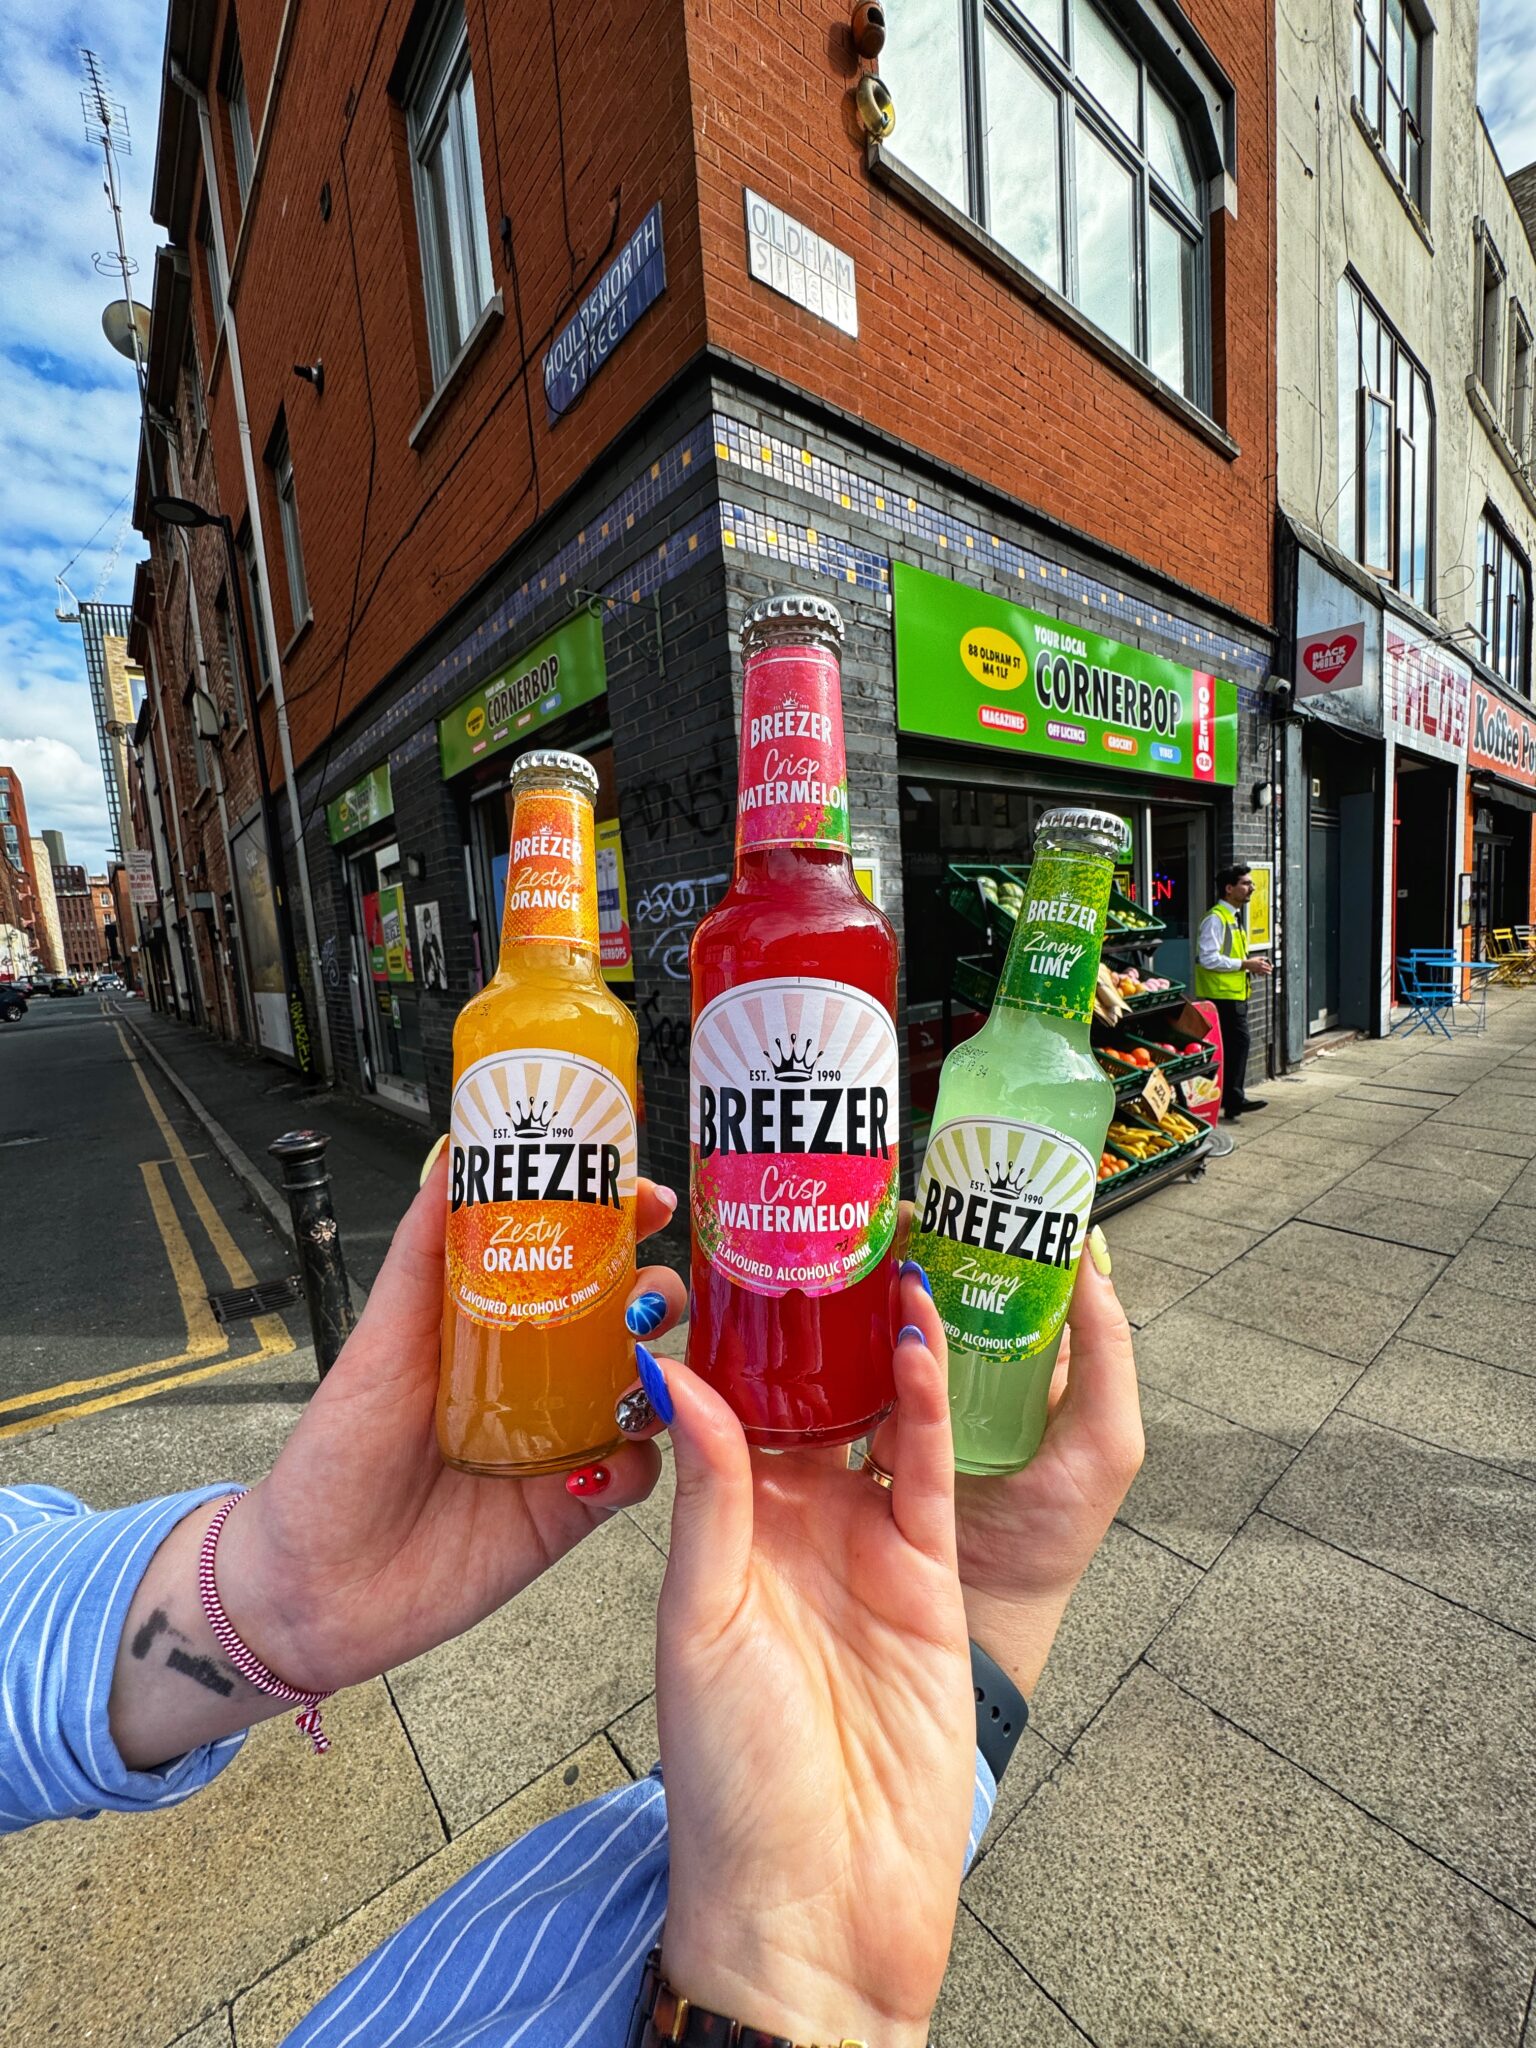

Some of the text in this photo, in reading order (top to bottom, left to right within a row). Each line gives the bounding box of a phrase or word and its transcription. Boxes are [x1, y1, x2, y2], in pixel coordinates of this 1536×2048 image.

[752, 204, 851, 292] OLDHAM
[546, 215, 656, 386] HOULDSWORTH
[569, 298, 629, 393] STREET
[967, 643, 1020, 670] 88 OLDHAM ST
[1034, 625, 1087, 658] YOUR LOCAL
[1312, 644, 1347, 660] BLACK
[982, 662, 994, 675] M4
[1312, 655, 1346, 671] MILK
[487, 654, 559, 729] CORNERBOP
[1035, 651, 1181, 736] CORNERBOP
[751, 711, 833, 749] BREEZER
[982, 708, 1025, 730] MAGAZINES
[1047, 723, 1085, 743] OFF LICENCE
[1199, 686, 1210, 752] OPEN
[1473, 692, 1536, 774] Koffee Po
[1108, 736, 1133, 752] GROCERY
[764, 748, 820, 783] Crisp
[738, 780, 848, 815] WATERMELON
[513, 835, 582, 865] BREEZER
[515, 867, 581, 892] Zesty
[510, 889, 580, 911] ORANGE
[1026, 899, 1098, 935] BREEZER
[1024, 931, 1087, 967] Zingy
[1029, 955, 1073, 980] LIME
[750, 1069, 841, 1082] EST. 1990
[493, 1127, 573, 1139] EST. 1990
[700, 1085, 890, 1160] BREEZER
[451, 1143, 621, 1214] BREEZER
[760, 1165, 827, 1209] Crisp
[970, 1179, 1044, 1206] EST. 1990
[490, 1216, 569, 1248] Zesty
[718, 1199, 870, 1234] WATERMELON
[920, 1178, 1078, 1270] BREEZER
[483, 1245, 574, 1272] ORANGE
[716, 1240, 872, 1281] FLAVOURED ALCOHOLIC DRINK
[952, 1256, 1026, 1301] Zingy
[460, 1281, 601, 1317] FLAVOURED ALCOHOLIC DRINK
[961, 1284, 1009, 1315] LIME
[961, 1329, 1041, 1349] ALCOHOLIC DRINK
